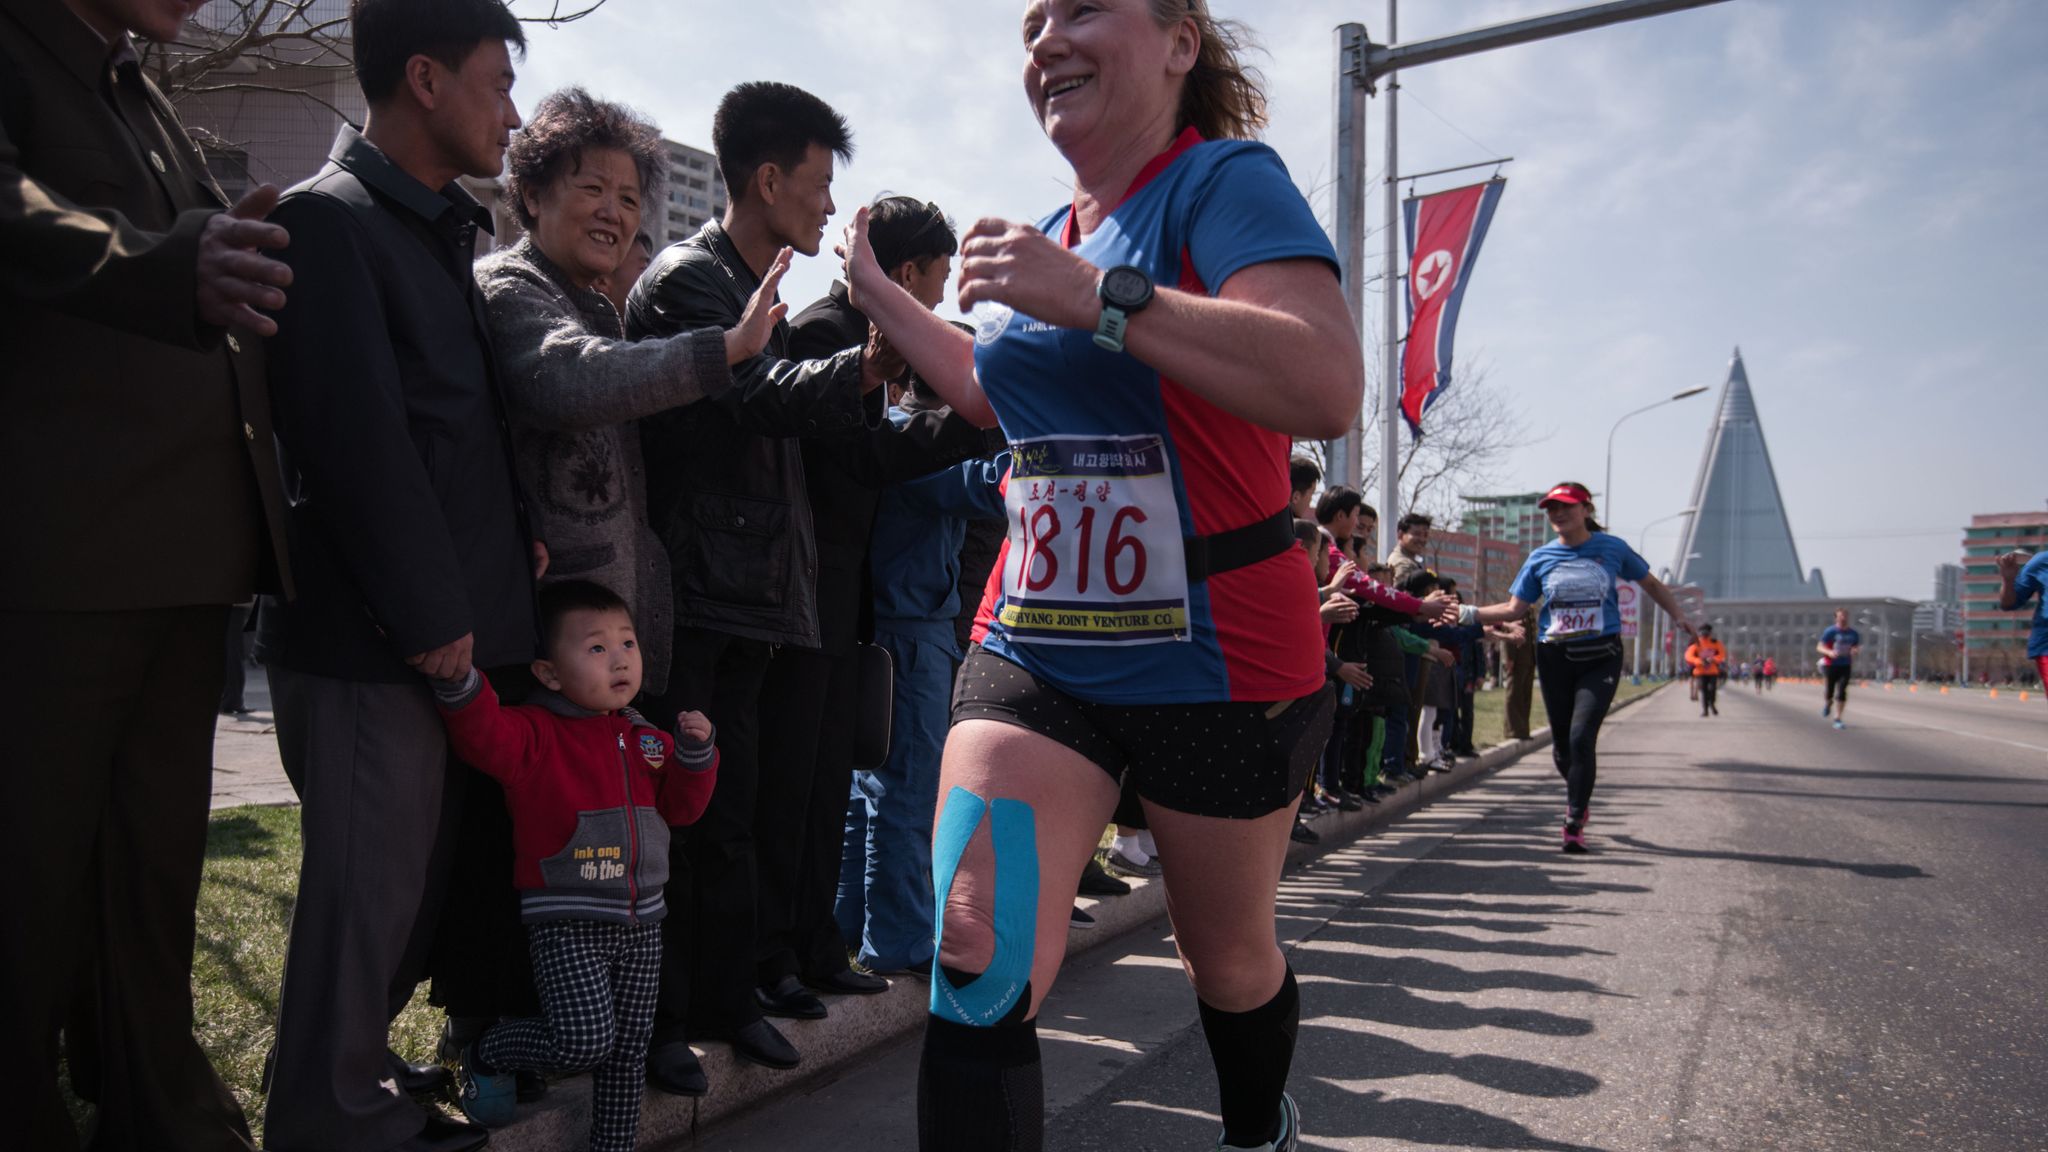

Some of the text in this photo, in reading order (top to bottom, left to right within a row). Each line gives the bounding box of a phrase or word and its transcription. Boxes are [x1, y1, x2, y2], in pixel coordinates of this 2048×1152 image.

[1028, 321, 1048, 333] APRIL
[1017, 504, 1148, 596] 1816
[1057, 613, 1089, 626] JOINT
[1093, 613, 1150, 628] VENTURE
[600, 860, 625, 880] the
